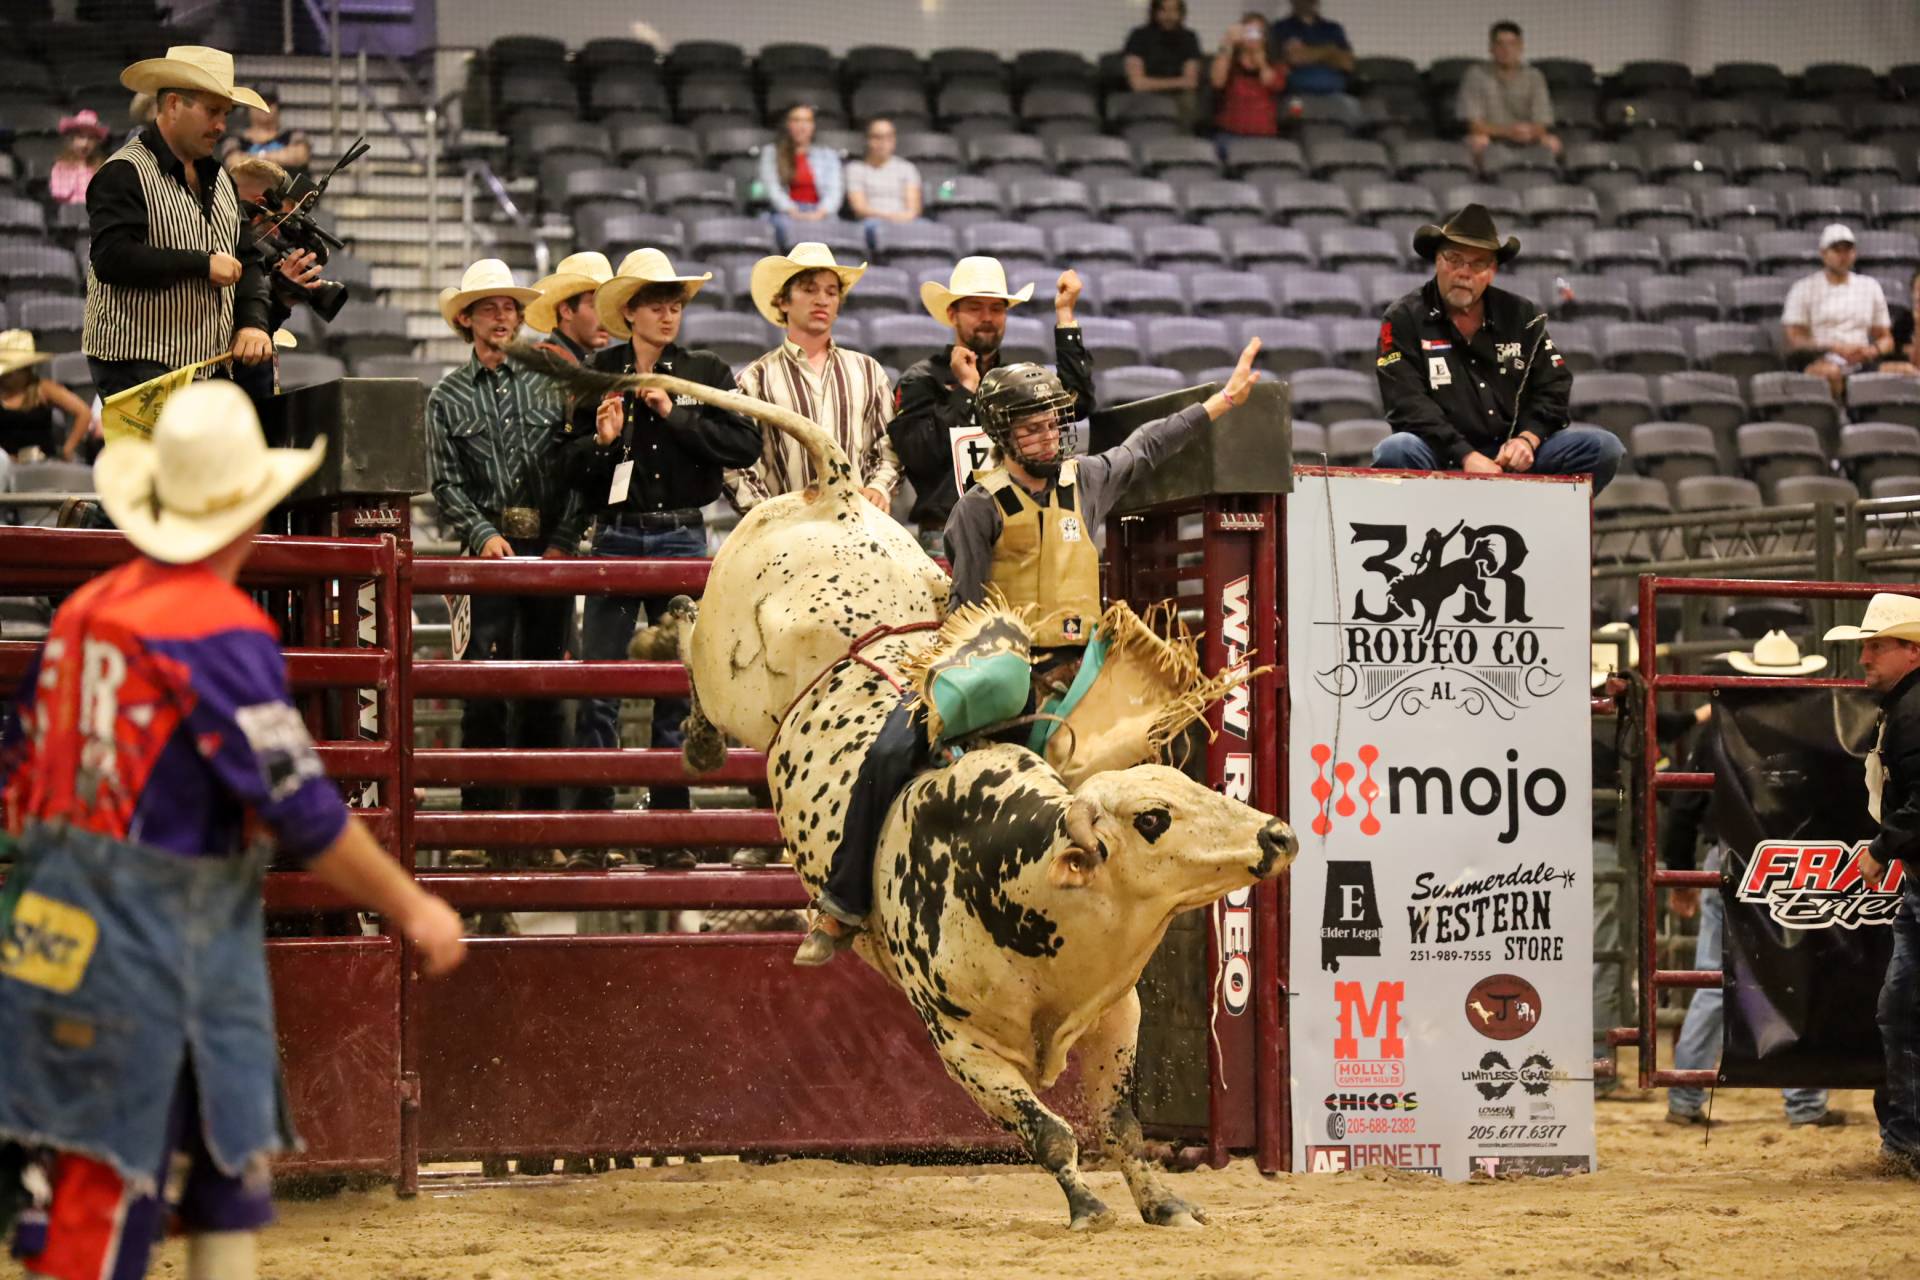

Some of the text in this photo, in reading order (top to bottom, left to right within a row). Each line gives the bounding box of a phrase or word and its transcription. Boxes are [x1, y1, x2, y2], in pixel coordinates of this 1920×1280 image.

[1346, 627, 1548, 666] RODEO CO.
[1430, 681, 1456, 700] AL
[1388, 748, 1567, 844] mojo
[1224, 753, 1251, 1016] REO
[1339, 885, 1365, 921] E
[1407, 890, 1551, 944] WESTERN
[1320, 927, 1382, 941] Elder Legal
[1410, 950, 1492, 961] 251-989-7555
[1505, 936, 1564, 961] STORE
[1334, 981, 1405, 1059] M
[1339, 1063, 1400, 1075] MOLLYS
[1347, 1118, 1416, 1134] 205-688-2382
[1468, 1125, 1567, 1140] 205.677.6377
[1354, 1144, 1441, 1167] ARNETT
